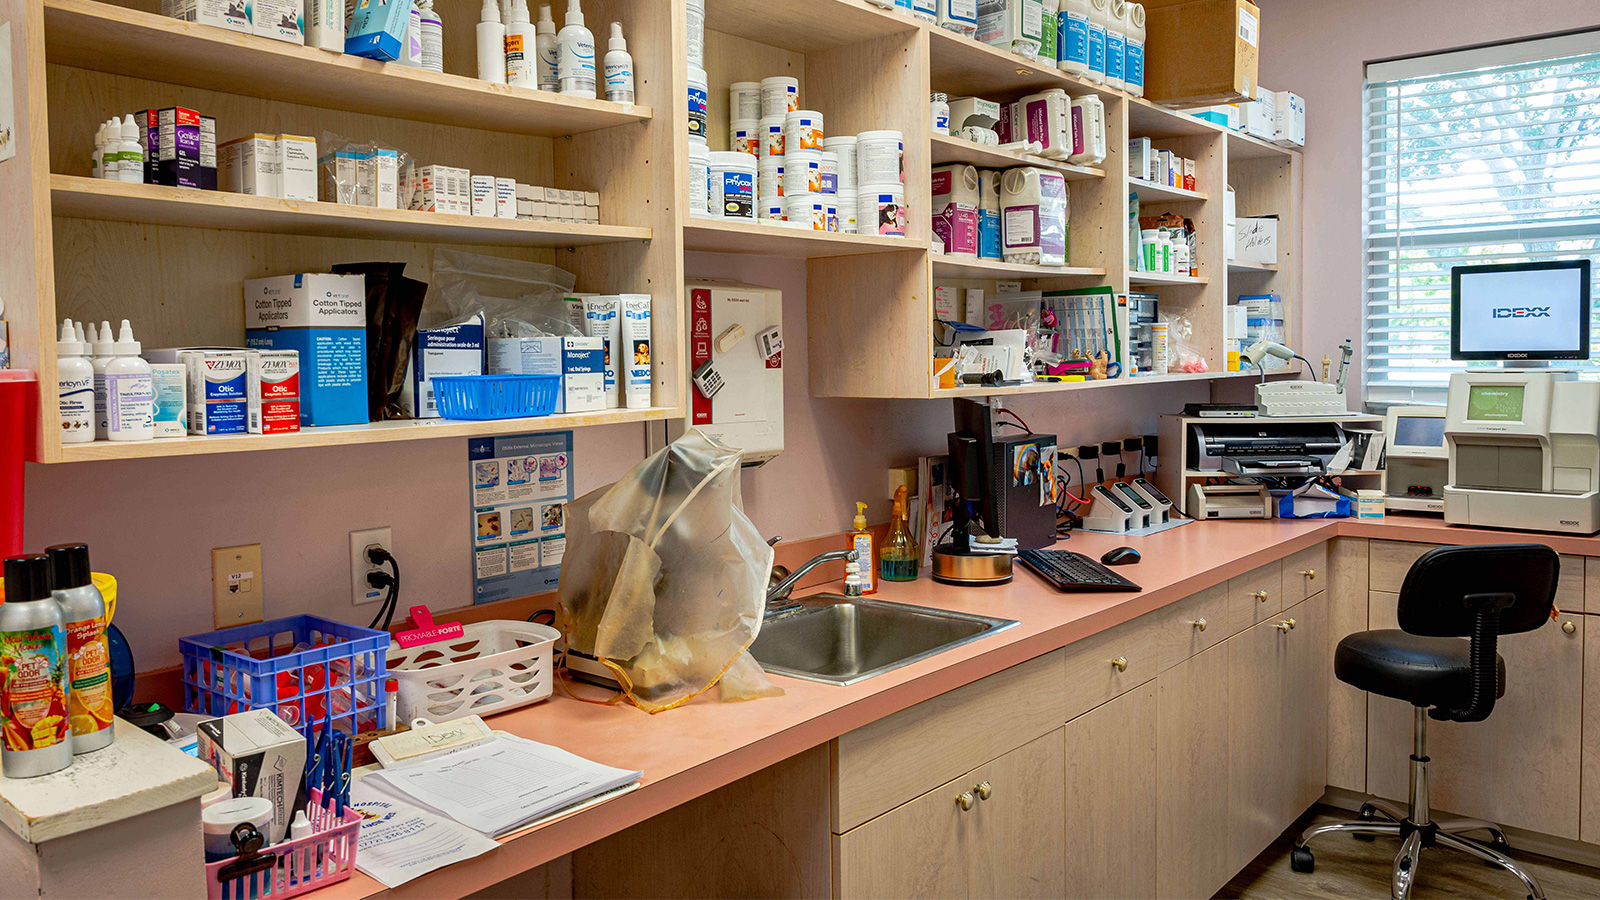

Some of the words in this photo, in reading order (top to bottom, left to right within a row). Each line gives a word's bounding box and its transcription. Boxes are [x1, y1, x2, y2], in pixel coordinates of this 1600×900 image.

[255, 300, 272, 309] Cotton
[273, 297, 291, 309] Tipped
[258, 311, 288, 322] Applicators
[1492, 306, 1550, 318] IDEXX
[214, 360, 242, 369] ZYMOX
[262, 360, 287, 368] ZYMOX
[59, 380, 80, 388] ericyn
[66, 625, 90, 635] Orange
[77, 631, 100, 639] Splash
[400, 625, 460, 642] PROVIABLE-FORTE
[13, 643, 42, 655] Mango
[86, 649, 97, 657] PET
[82, 655, 100, 665] ODOR
[18, 670, 40, 678] ODOR
[359, 838, 383, 847] (772)
[385, 823, 426, 839] 336-8111
